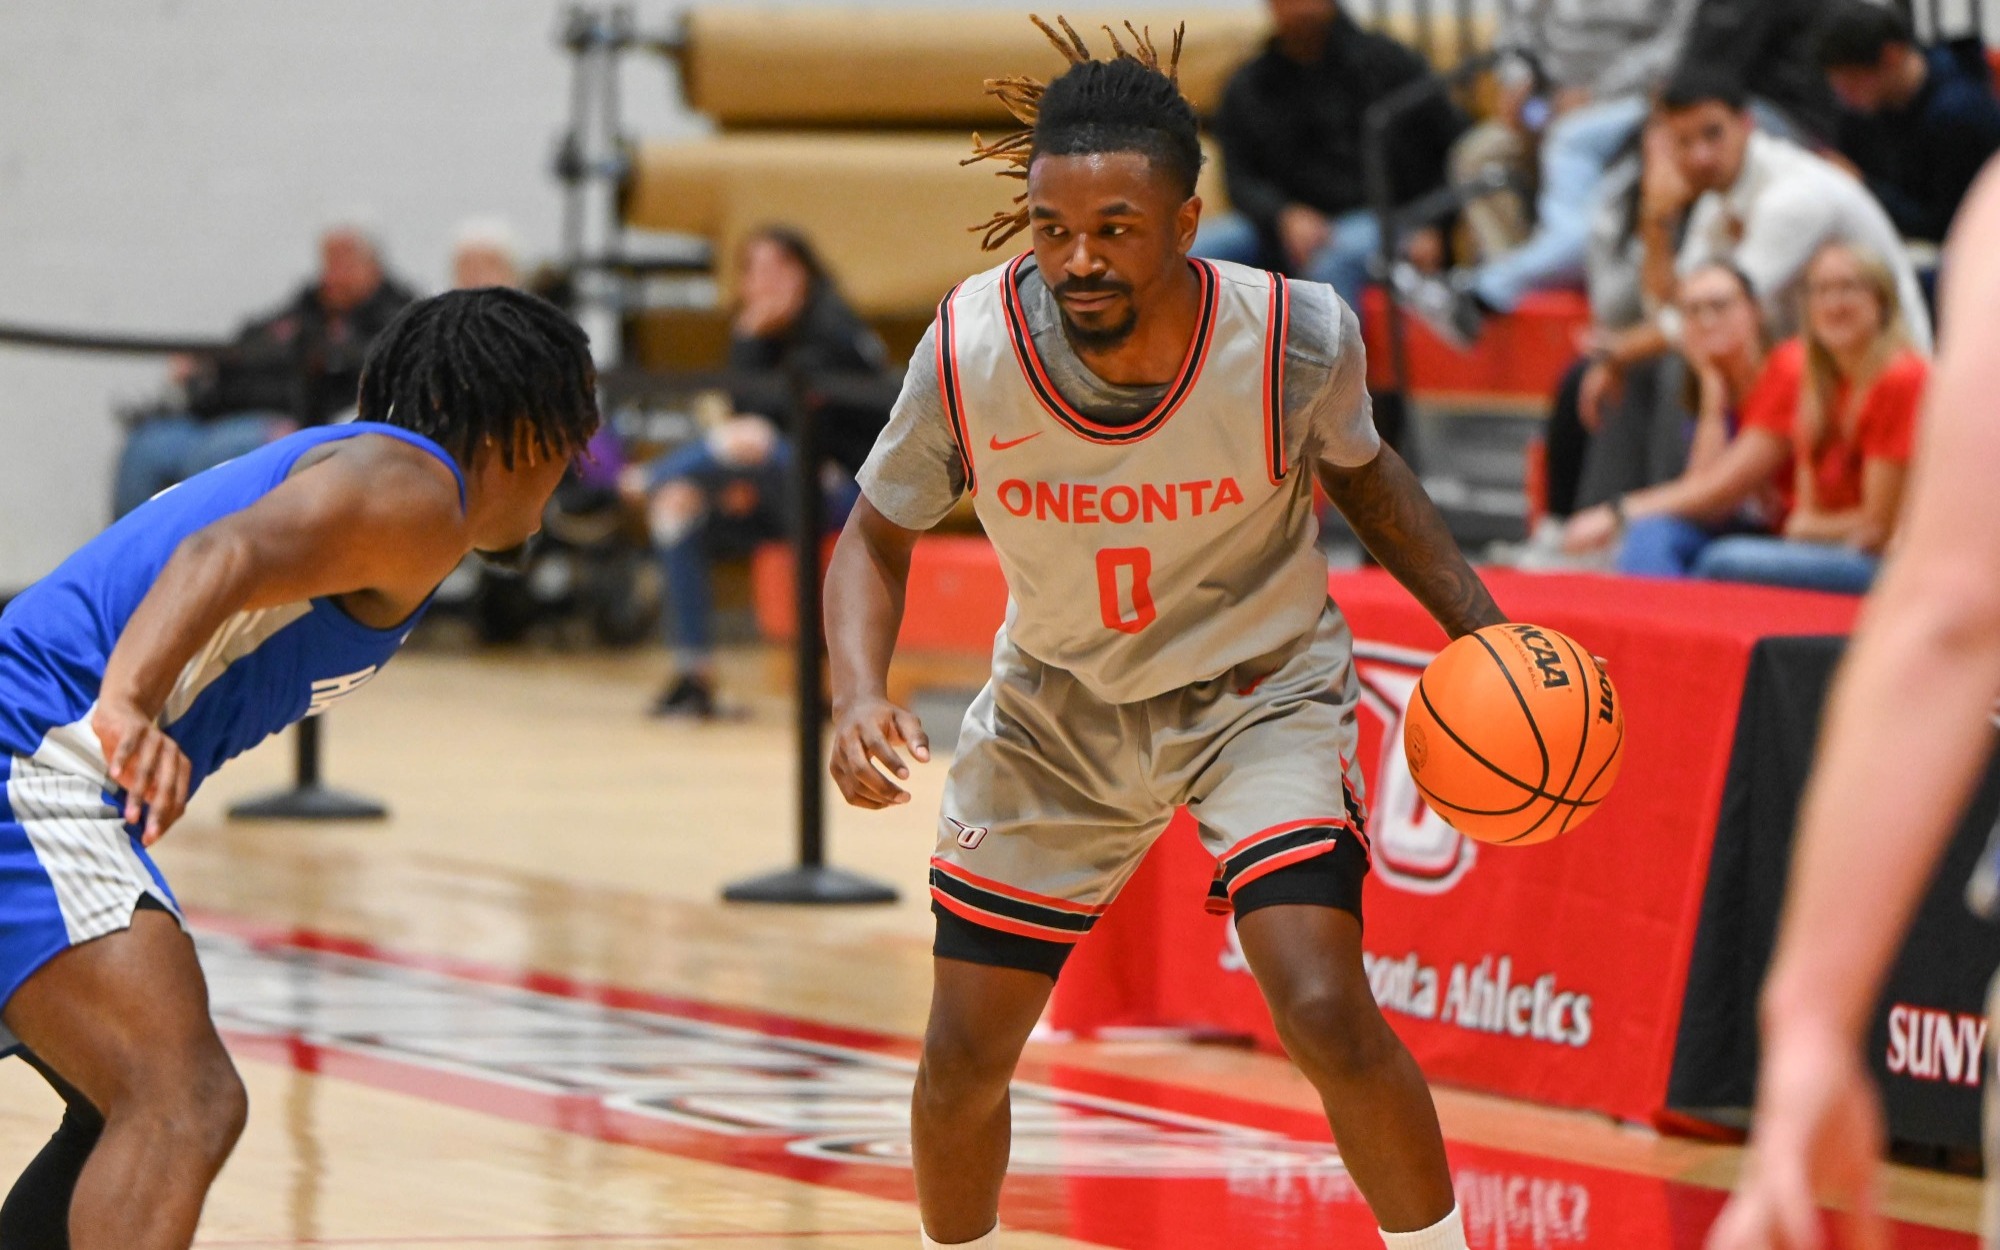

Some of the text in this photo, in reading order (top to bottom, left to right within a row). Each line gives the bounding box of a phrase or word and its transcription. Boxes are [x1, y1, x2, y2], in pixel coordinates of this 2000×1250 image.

[997, 477, 1245, 524] ONEONTA
[1095, 546, 1156, 634] 0
[1504, 625, 1570, 689] NCAA
[1440, 953, 1592, 1047] Athletics
[1886, 1003, 1988, 1086] SUNY
